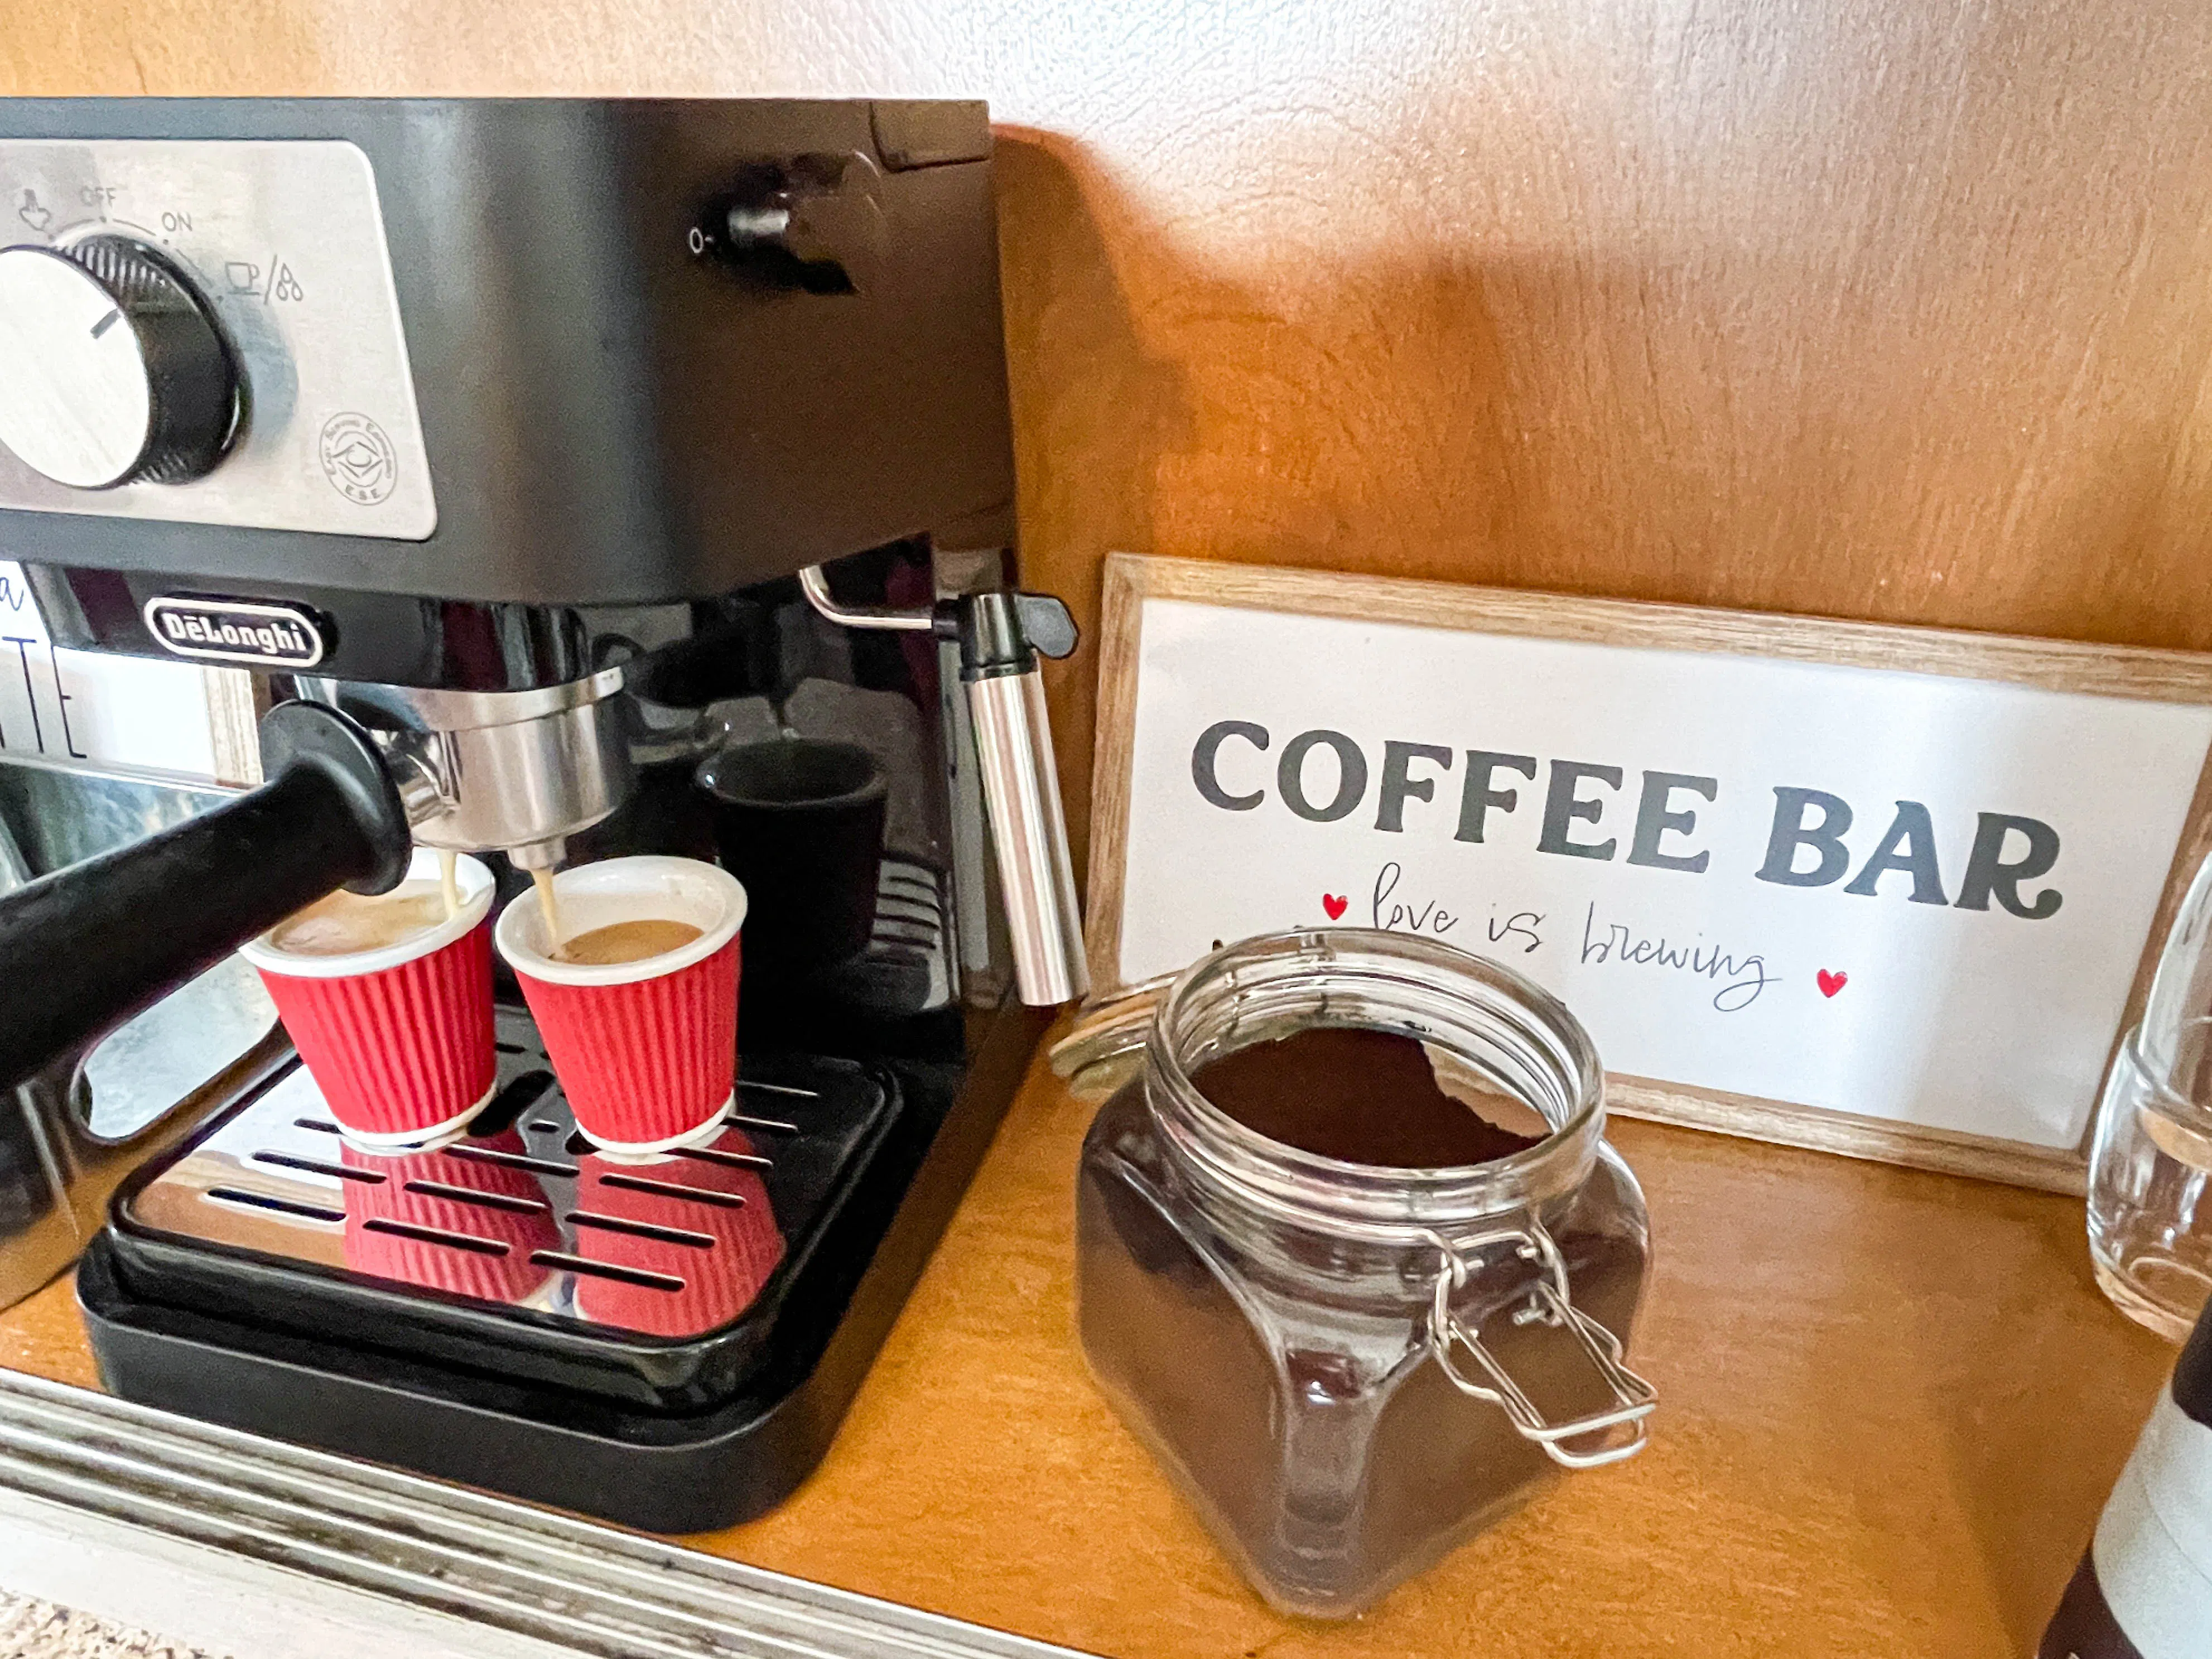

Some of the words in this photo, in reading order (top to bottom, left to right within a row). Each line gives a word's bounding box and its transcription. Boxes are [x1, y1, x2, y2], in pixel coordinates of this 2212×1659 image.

[81, 185, 117, 209] OFF
[161, 211, 193, 233] ON
[1192, 720, 1718, 874] COFFEE
[1755, 786, 2064, 920] BAR
[1373, 862, 1459, 933] love
[1488, 902, 1547, 953] is
[1581, 900, 1784, 1012] brewing
